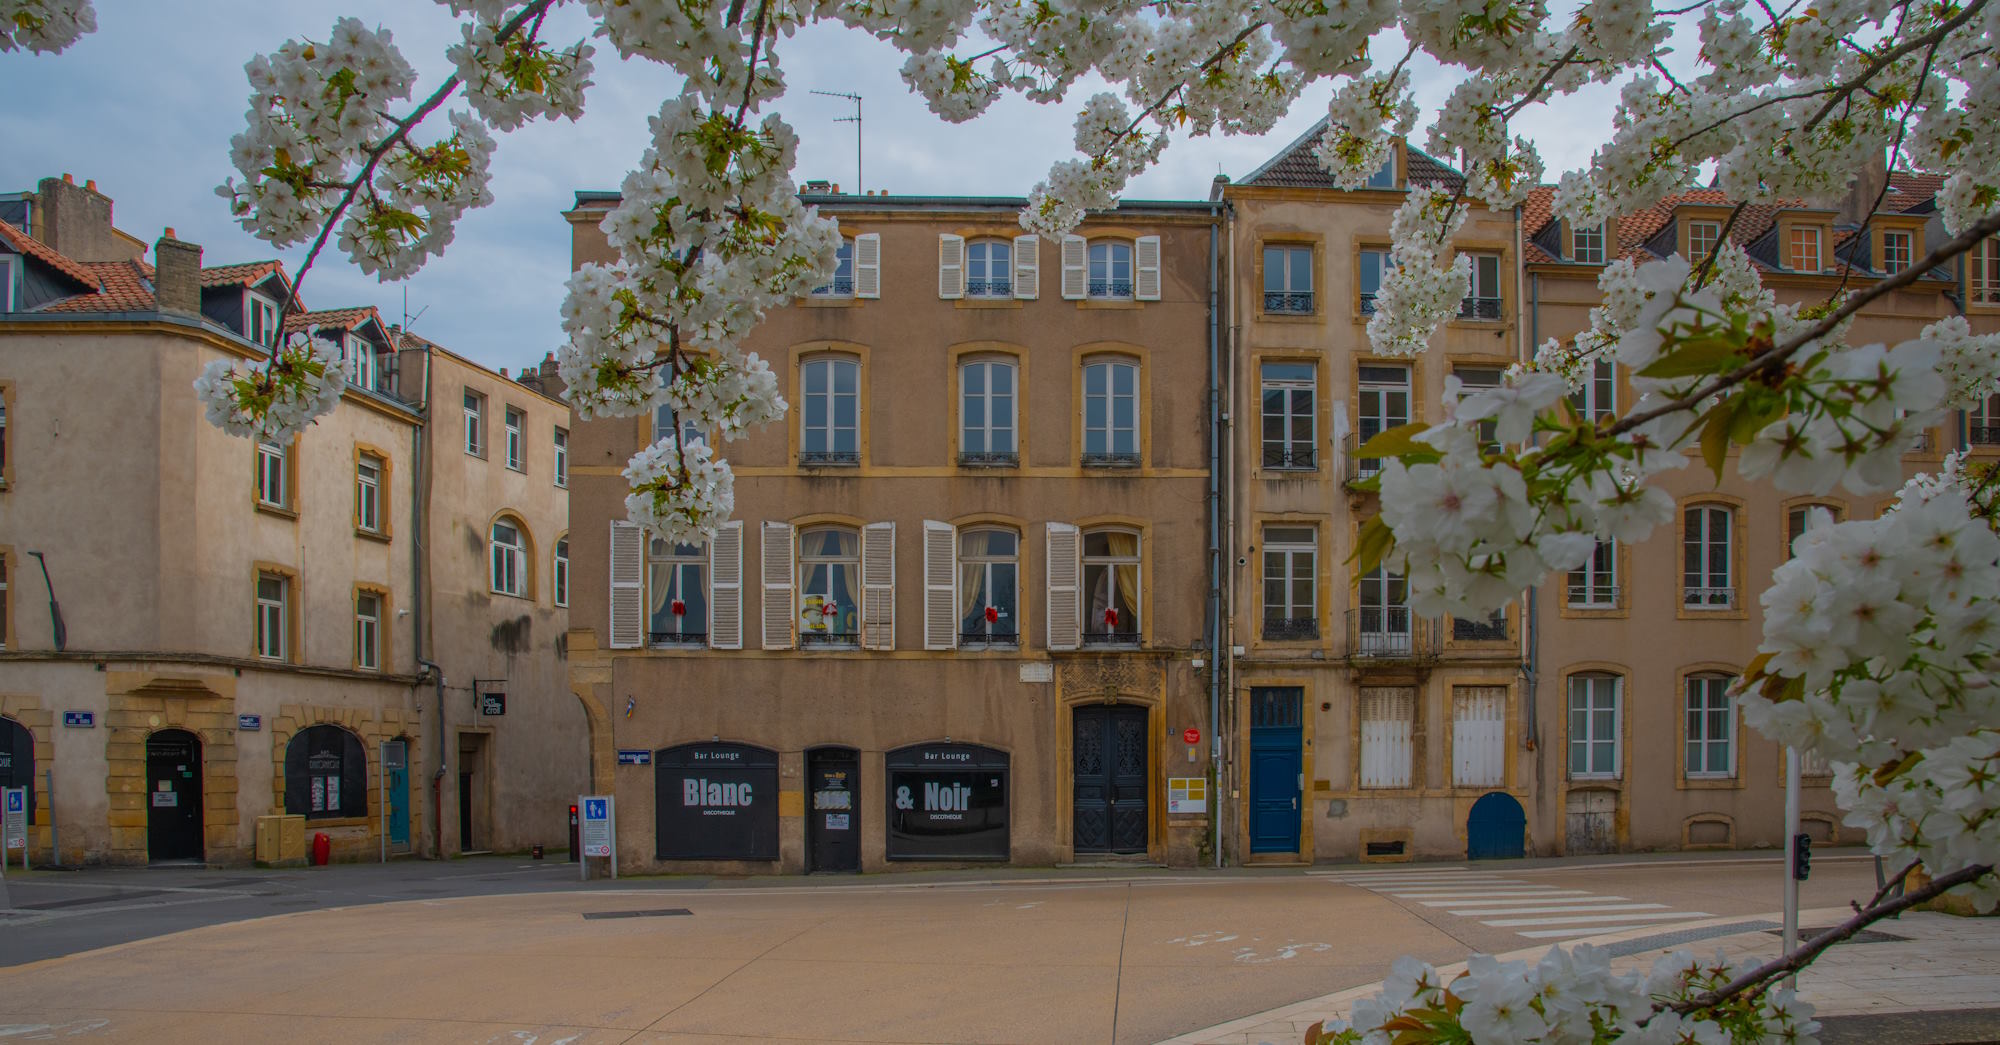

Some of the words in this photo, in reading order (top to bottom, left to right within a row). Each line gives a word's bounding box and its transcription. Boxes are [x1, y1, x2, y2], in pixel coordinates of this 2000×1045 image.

[711, 752, 740, 760] Lounge
[924, 752, 938, 760] Bar
[941, 752, 970, 761] Lounge
[683, 778, 753, 806] Blanc
[896, 785, 914, 810] &
[924, 782, 971, 811] Noir
